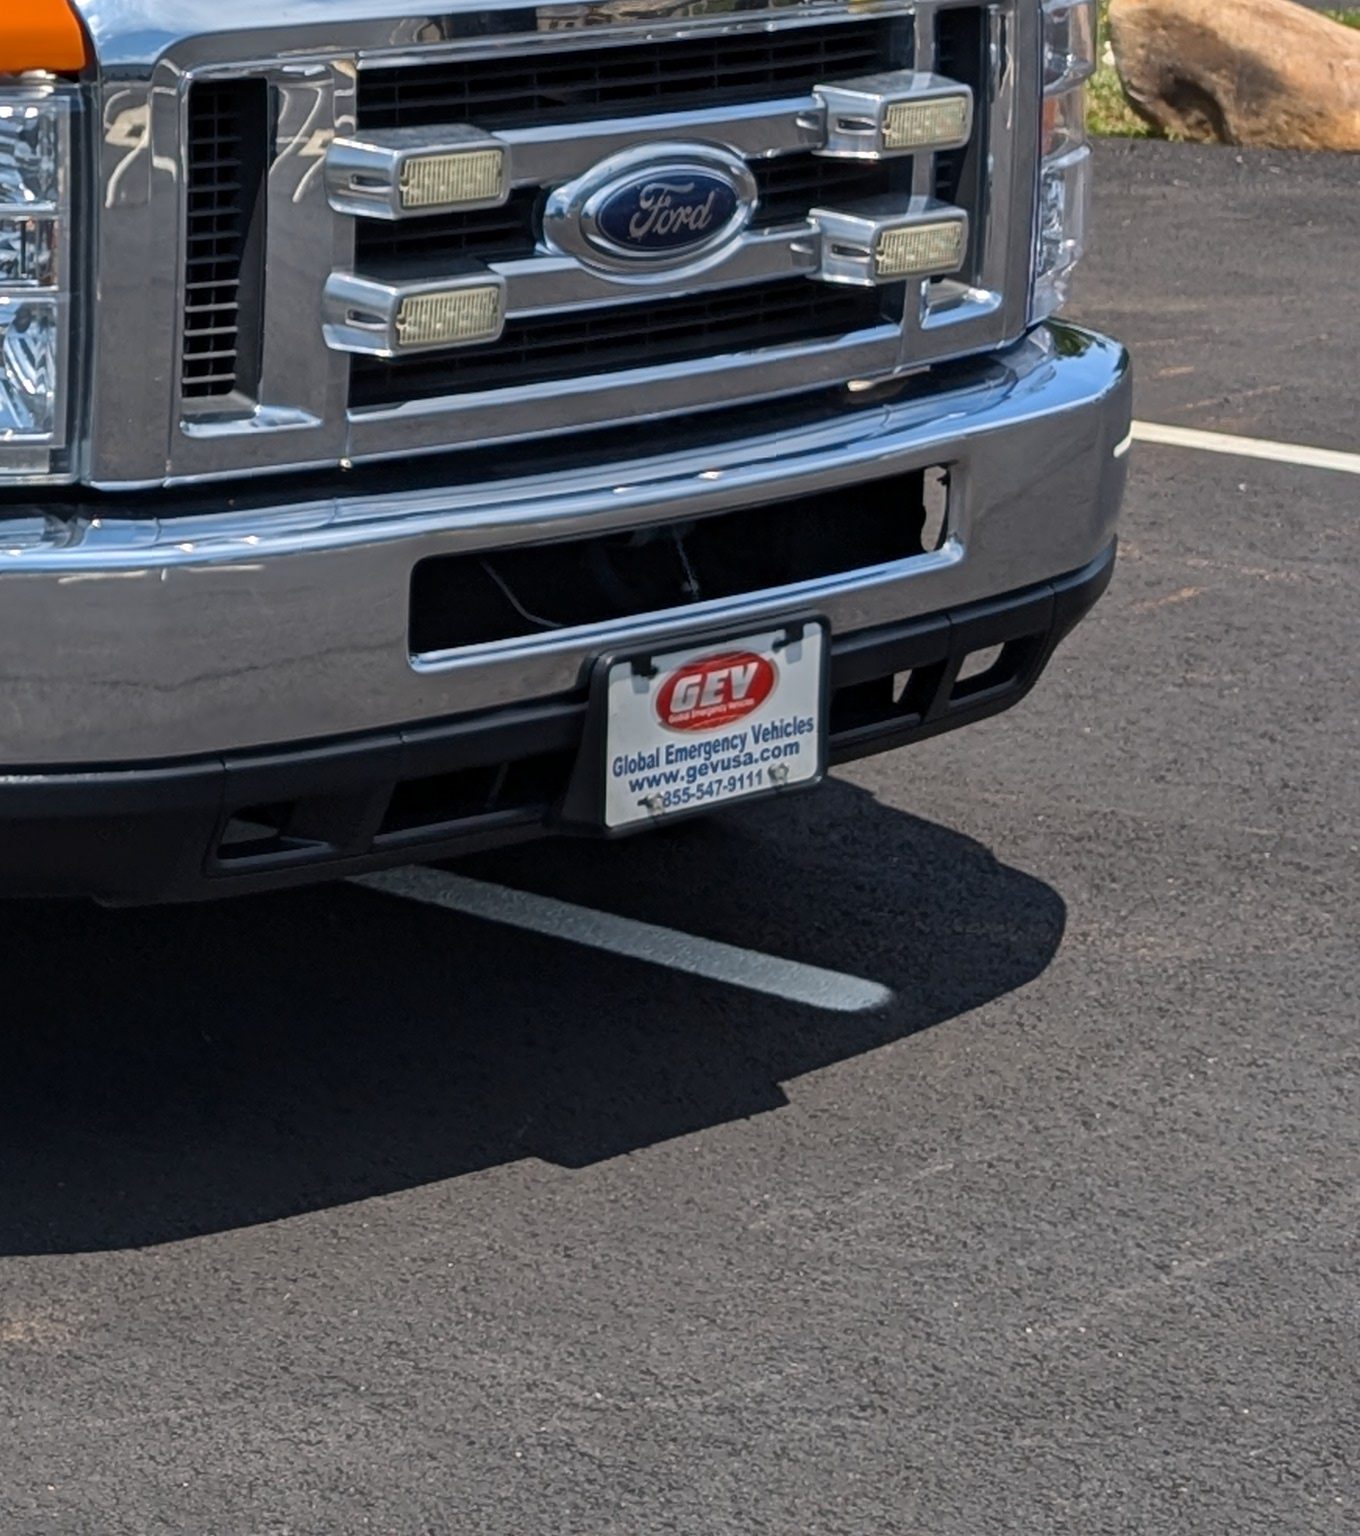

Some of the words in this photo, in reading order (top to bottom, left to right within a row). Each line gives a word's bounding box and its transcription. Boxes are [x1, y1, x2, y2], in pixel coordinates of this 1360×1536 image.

[629, 181, 716, 242] Ford
[669, 661, 760, 714] GEV
[612, 746, 660, 777] Global
[665, 731, 748, 765] Emergency
[751, 715, 815, 745] Vehicles
[628, 740, 800, 793] www.gevusa.com
[662, 768, 763, 808] 855-547-9111
